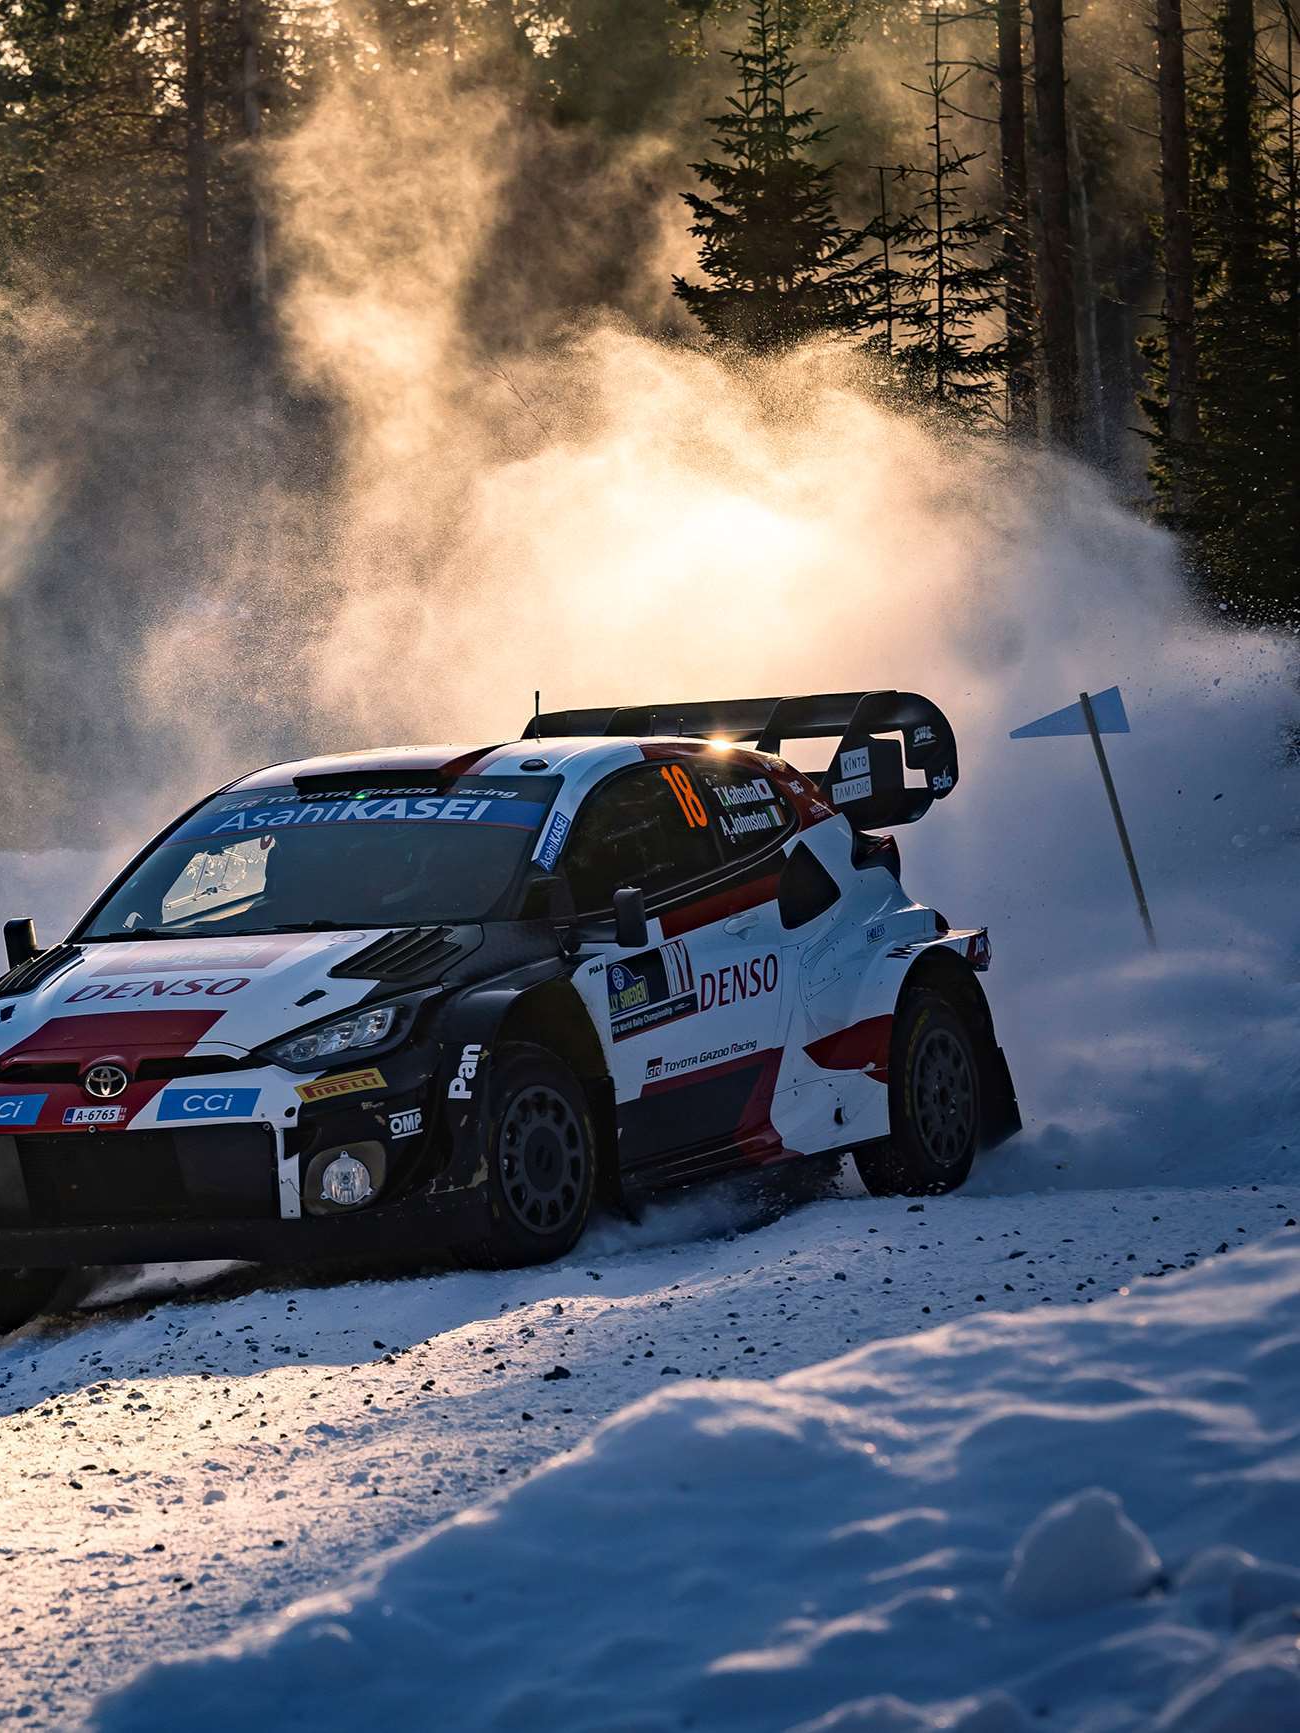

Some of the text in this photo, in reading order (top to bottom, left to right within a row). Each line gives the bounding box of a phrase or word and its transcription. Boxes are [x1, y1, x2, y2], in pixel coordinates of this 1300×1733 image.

[267, 789, 350, 804] TOYOTA
[448, 787, 519, 799] acing
[660, 764, 708, 828] 18
[211, 799, 492, 834] AsahiKASEI
[539, 812, 569, 871] AsahiKASEI
[63, 977, 251, 1003] DENSO
[620, 980, 648, 1009] SWEDEN
[700, 953, 778, 1012] DENSO
[448, 1044, 482, 1099] Pan
[664, 1055, 698, 1073] TOYOTA
[699, 1047, 729, 1063] GAZOO
[730, 1040, 757, 1055] Racing
[302, 1072, 378, 1099] PIRELLI
[76, 1109, 116, 1121] A-6765
[390, 1112, 422, 1134] OMP
